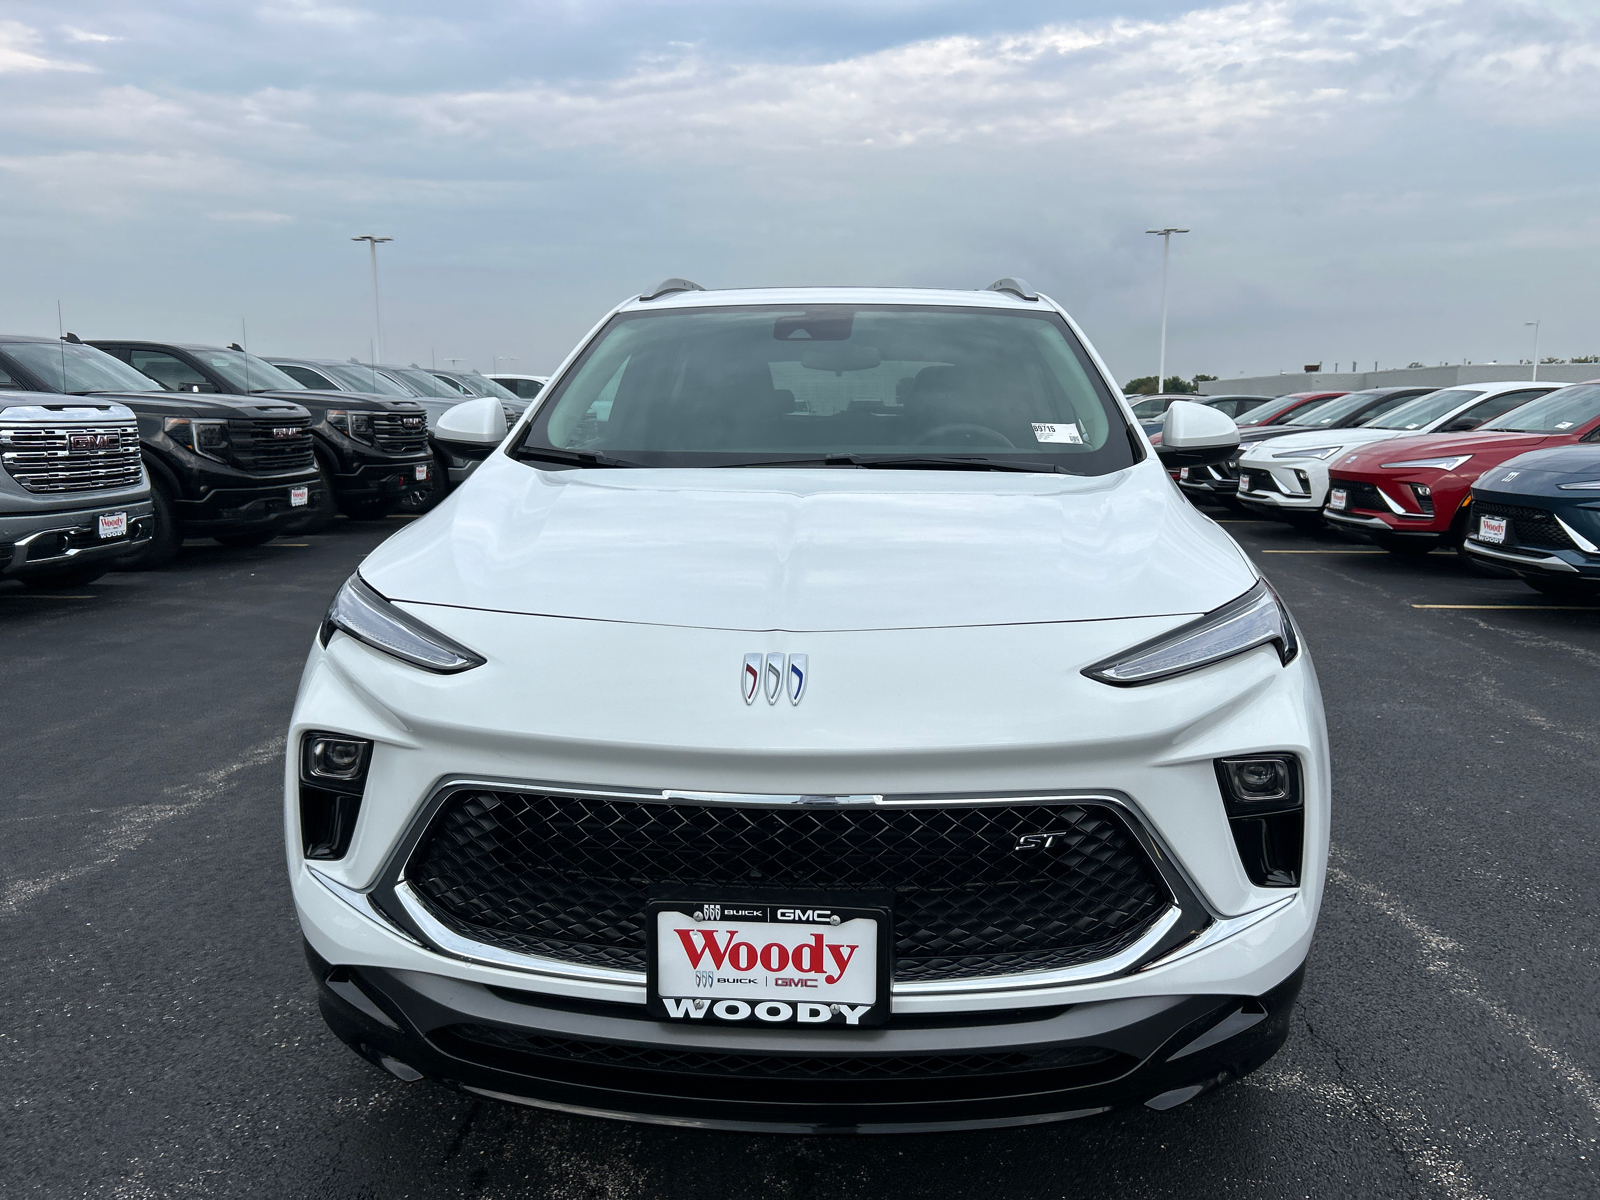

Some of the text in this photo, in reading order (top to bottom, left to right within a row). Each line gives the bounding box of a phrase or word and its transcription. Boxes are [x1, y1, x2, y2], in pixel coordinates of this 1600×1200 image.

[70, 435, 119, 450] GMC
[101, 516, 124, 528] Woody
[1483, 521, 1503, 535] Woody
[100, 530, 126, 539] WOODY
[1478, 535, 1504, 544] WOODY
[1015, 830, 1067, 851] ST
[724, 908, 831, 922] BUICK GMC
[673, 929, 859, 985] Woody
[717, 977, 818, 988] BUICK GMC
[662, 998, 872, 1024] WOODY
